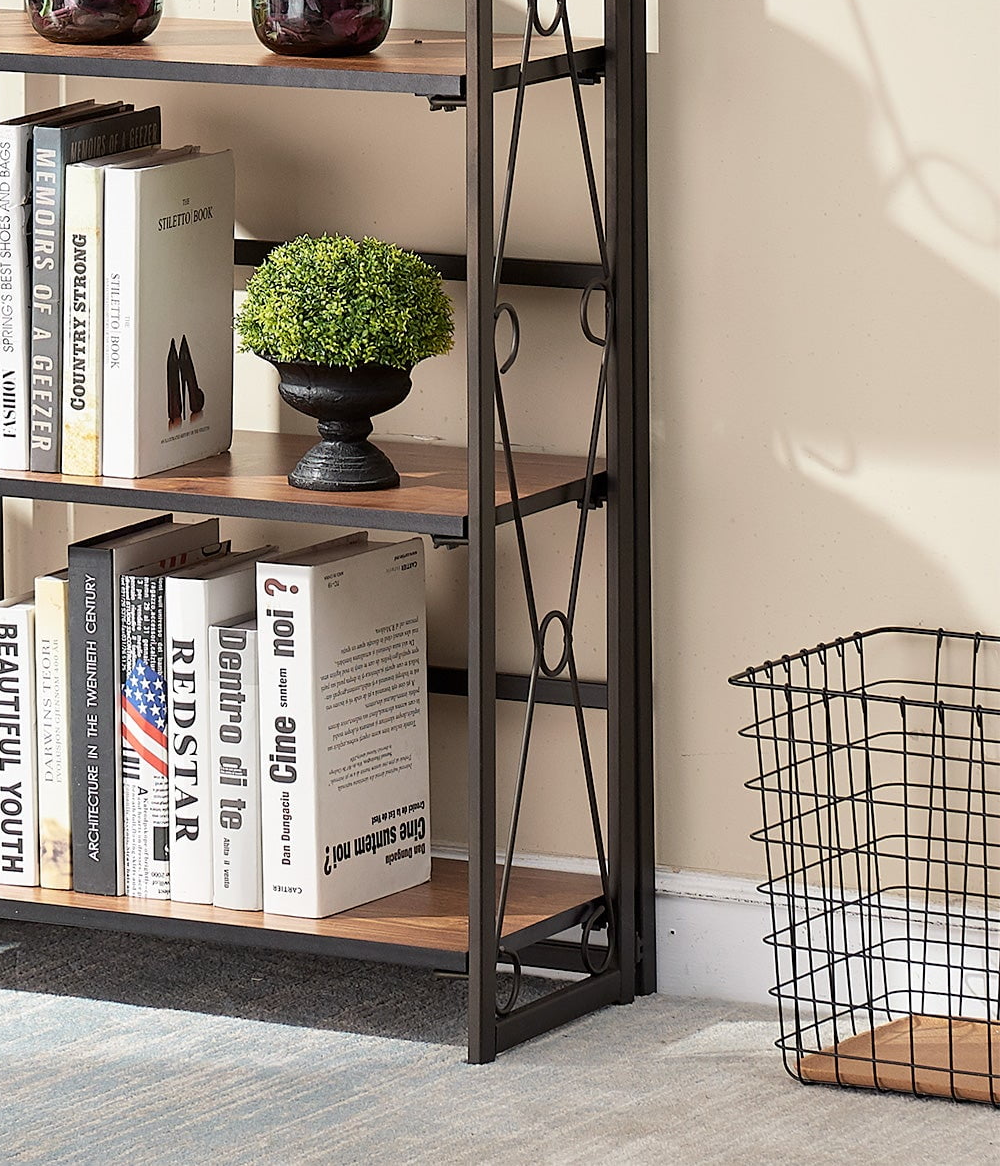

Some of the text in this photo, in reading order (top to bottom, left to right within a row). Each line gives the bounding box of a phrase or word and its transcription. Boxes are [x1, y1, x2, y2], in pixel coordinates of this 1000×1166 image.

[70, 135, 106, 163] MEMOIRS
[129, 122, 158, 148] GEEZER
[0, 141, 14, 353] SPRING'S BEST SHOES AND BAGS
[158, 206, 213, 232] STILETTO BOOK
[31, 148, 57, 452] MEMOIRS OF A GEEZER
[70, 233, 87, 411] COUNTRY STRONG
[110, 272, 121, 369] STILETTO BOOK
[2, 370, 17, 438] FASHION
[264, 578, 299, 597] ?
[266, 608, 295, 657] noi
[41, 639, 53, 782] DARWINS TEORI
[85, 574, 101, 862] ARCHITECTURE IN THE TWENTIETH CENTURY
[218, 629, 248, 830] Dentro di te
[269, 715, 297, 784] Cine
[0, 781, 24, 873] YOUTH
[280, 791, 292, 841] Dungaciu
[354, 825, 397, 857] suntem
[399, 816, 426, 842] Cine
[281, 845, 291, 865] Dan
[413, 842, 426, 854] Dan
[272, 885, 303, 895] CARTIER
